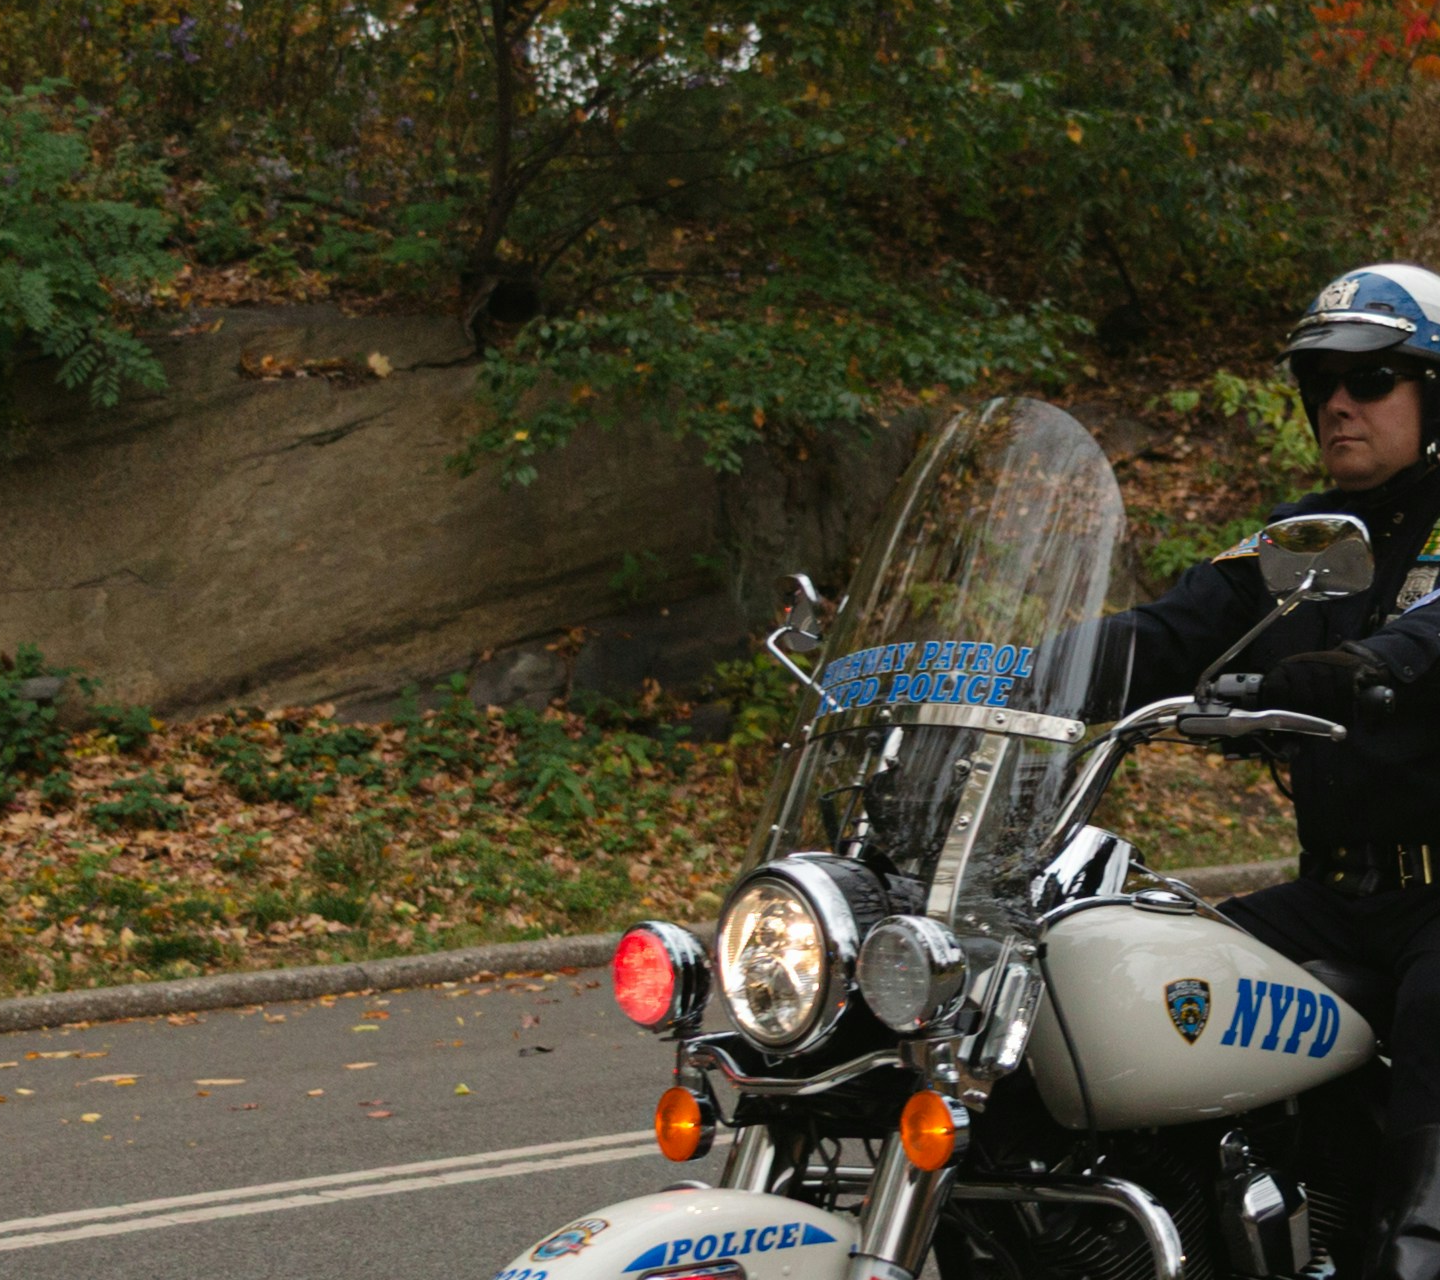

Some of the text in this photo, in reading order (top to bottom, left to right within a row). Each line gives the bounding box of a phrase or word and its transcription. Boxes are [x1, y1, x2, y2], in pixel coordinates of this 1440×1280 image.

[821, 640, 1033, 689] HIGHWAY PATROL
[816, 672, 1015, 719] NYPD POLICE
[1220, 978, 1340, 1058] NYPD
[668, 1222, 801, 1265] POLICE
